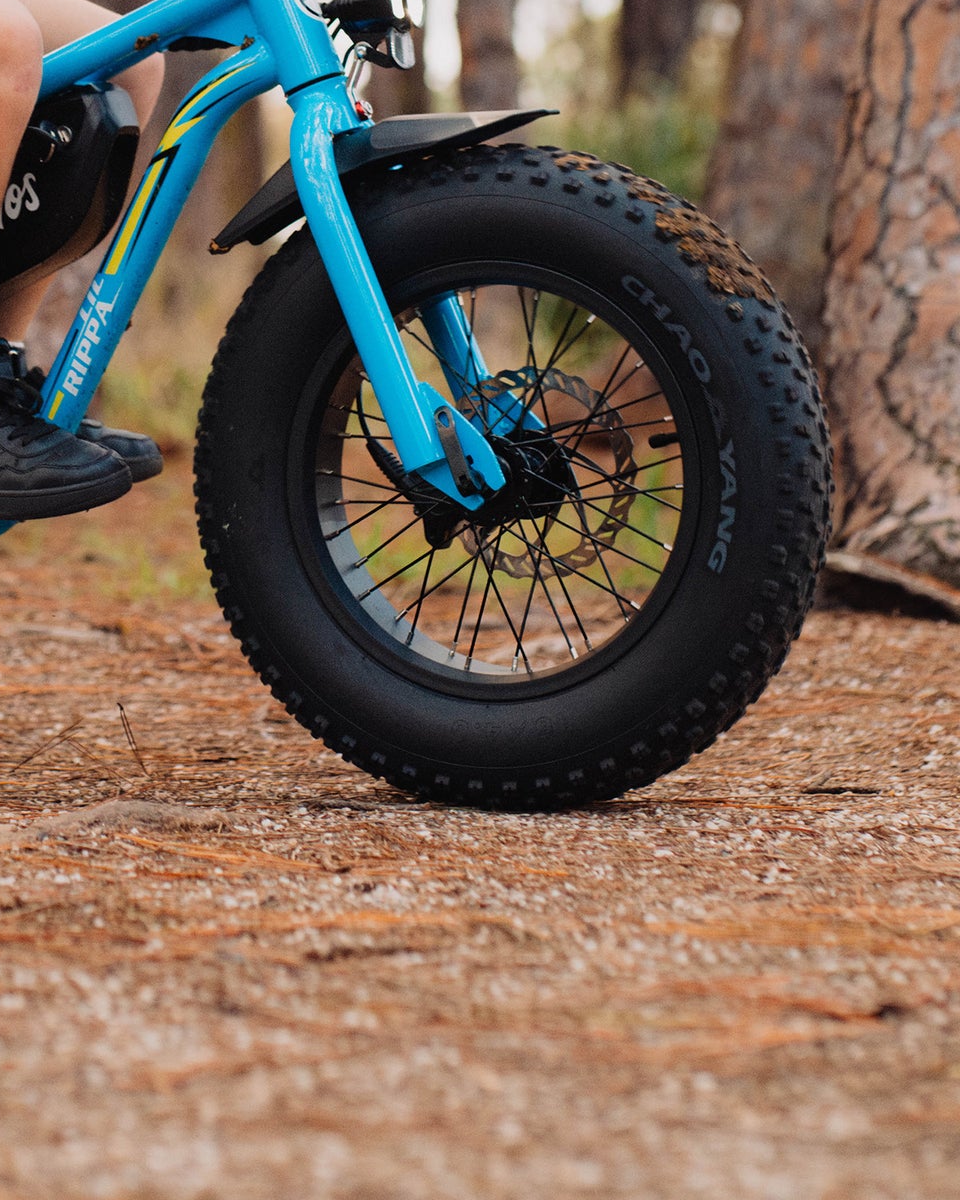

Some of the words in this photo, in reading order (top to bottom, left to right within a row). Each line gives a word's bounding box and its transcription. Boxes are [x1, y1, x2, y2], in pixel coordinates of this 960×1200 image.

[62, 283, 123, 397] RIPPA
[622, 275, 712, 383] CHAO
[708, 438, 738, 574] YANG
